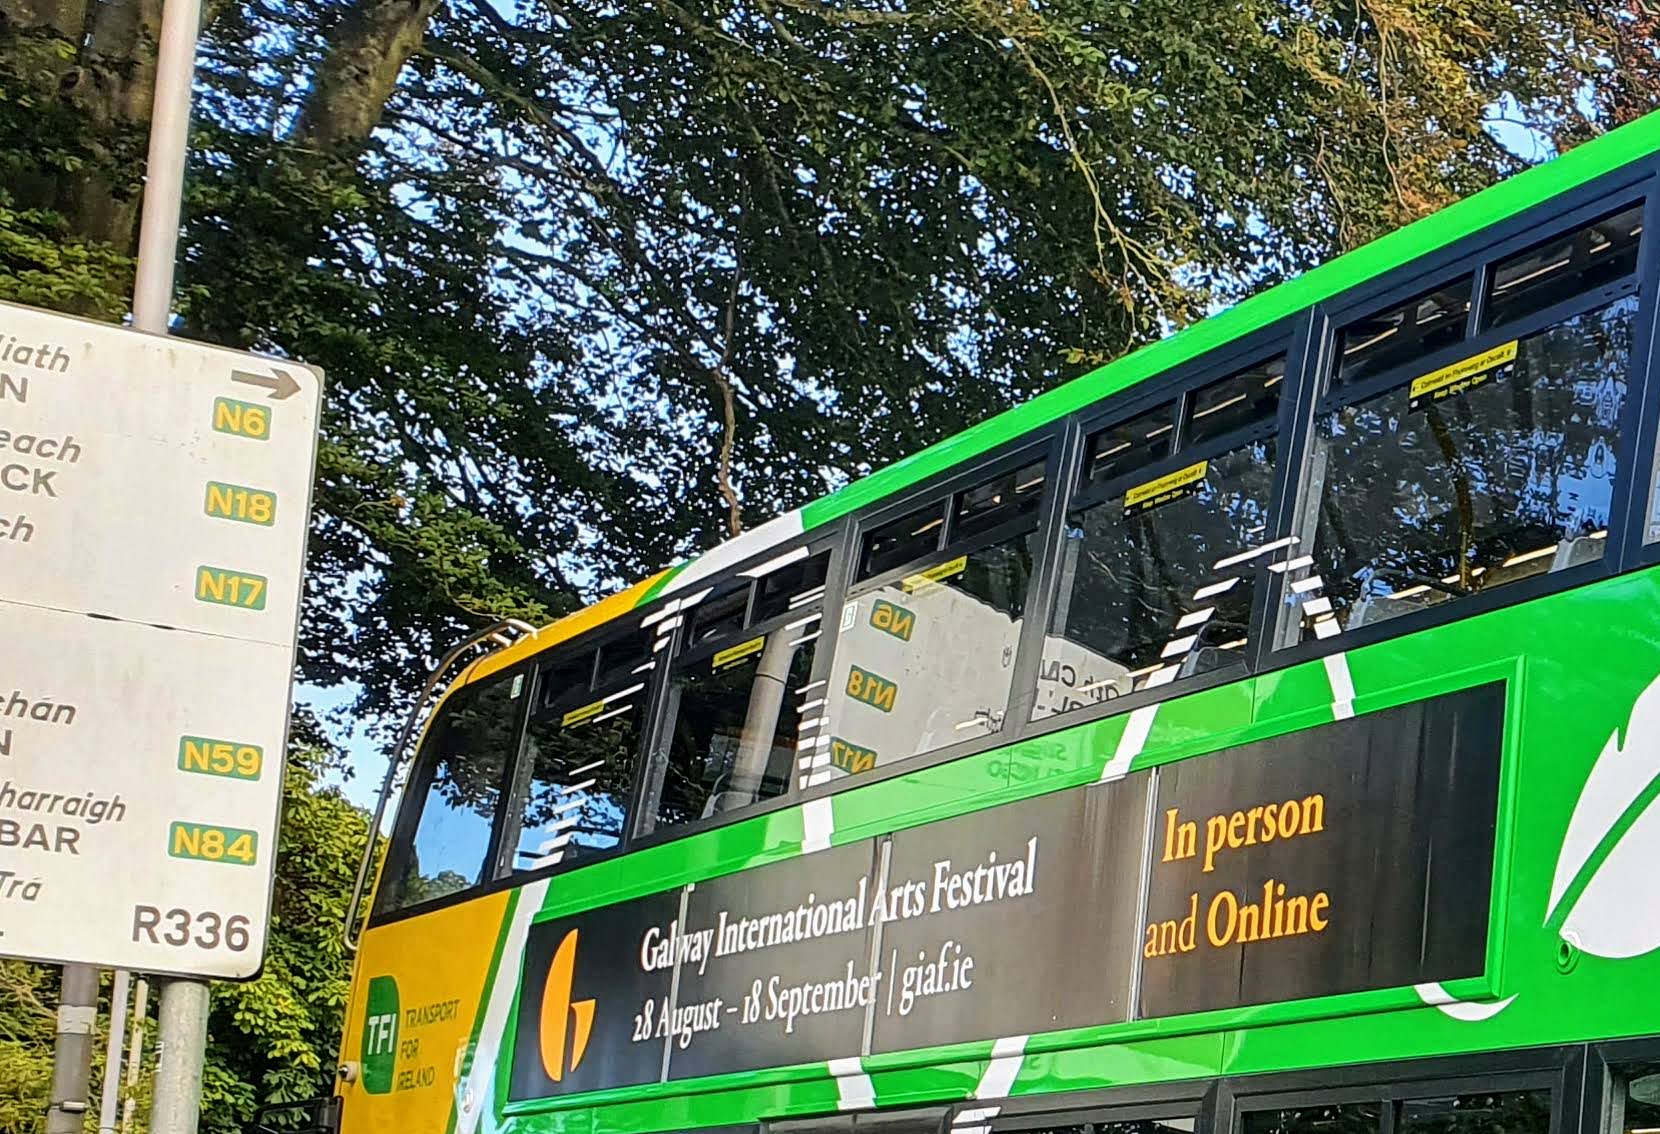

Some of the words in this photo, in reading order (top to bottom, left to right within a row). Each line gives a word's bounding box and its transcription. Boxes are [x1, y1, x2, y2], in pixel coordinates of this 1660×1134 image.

[217, 405, 265, 437] N6
[1, 464, 57, 497] CK
[208, 486, 271, 521] N18
[199, 569, 262, 606] N17
[4, 691, 76, 725] hán
[185, 741, 260, 774] N59
[0, 781, 126, 824] harraigh
[0, 819, 80, 854] BAR
[175, 826, 253, 861] N84
[1162, 808, 1196, 862] In
[1202, 793, 1324, 872] person
[641, 919, 714, 976] Galway
[716, 876, 867, 957] International
[868, 883, 926, 926] Arts
[929, 836, 1038, 914] Festival
[1143, 893, 1196, 958] and
[1206, 879, 1328, 947] Online
[133, 906, 251, 951] R336
[632, 1005, 653, 1042] 28
[653, 996, 723, 1049] August
[741, 983, 762, 1025] 18
[765, 961, 881, 1033] September
[901, 941, 974, 1016] giaf.ie
[406, 999, 460, 1028] TRANSPORT
[368, 1013, 397, 1055] TFI
[402, 1039, 419, 1059] FOR
[398, 1067, 435, 1091] IRELAND
